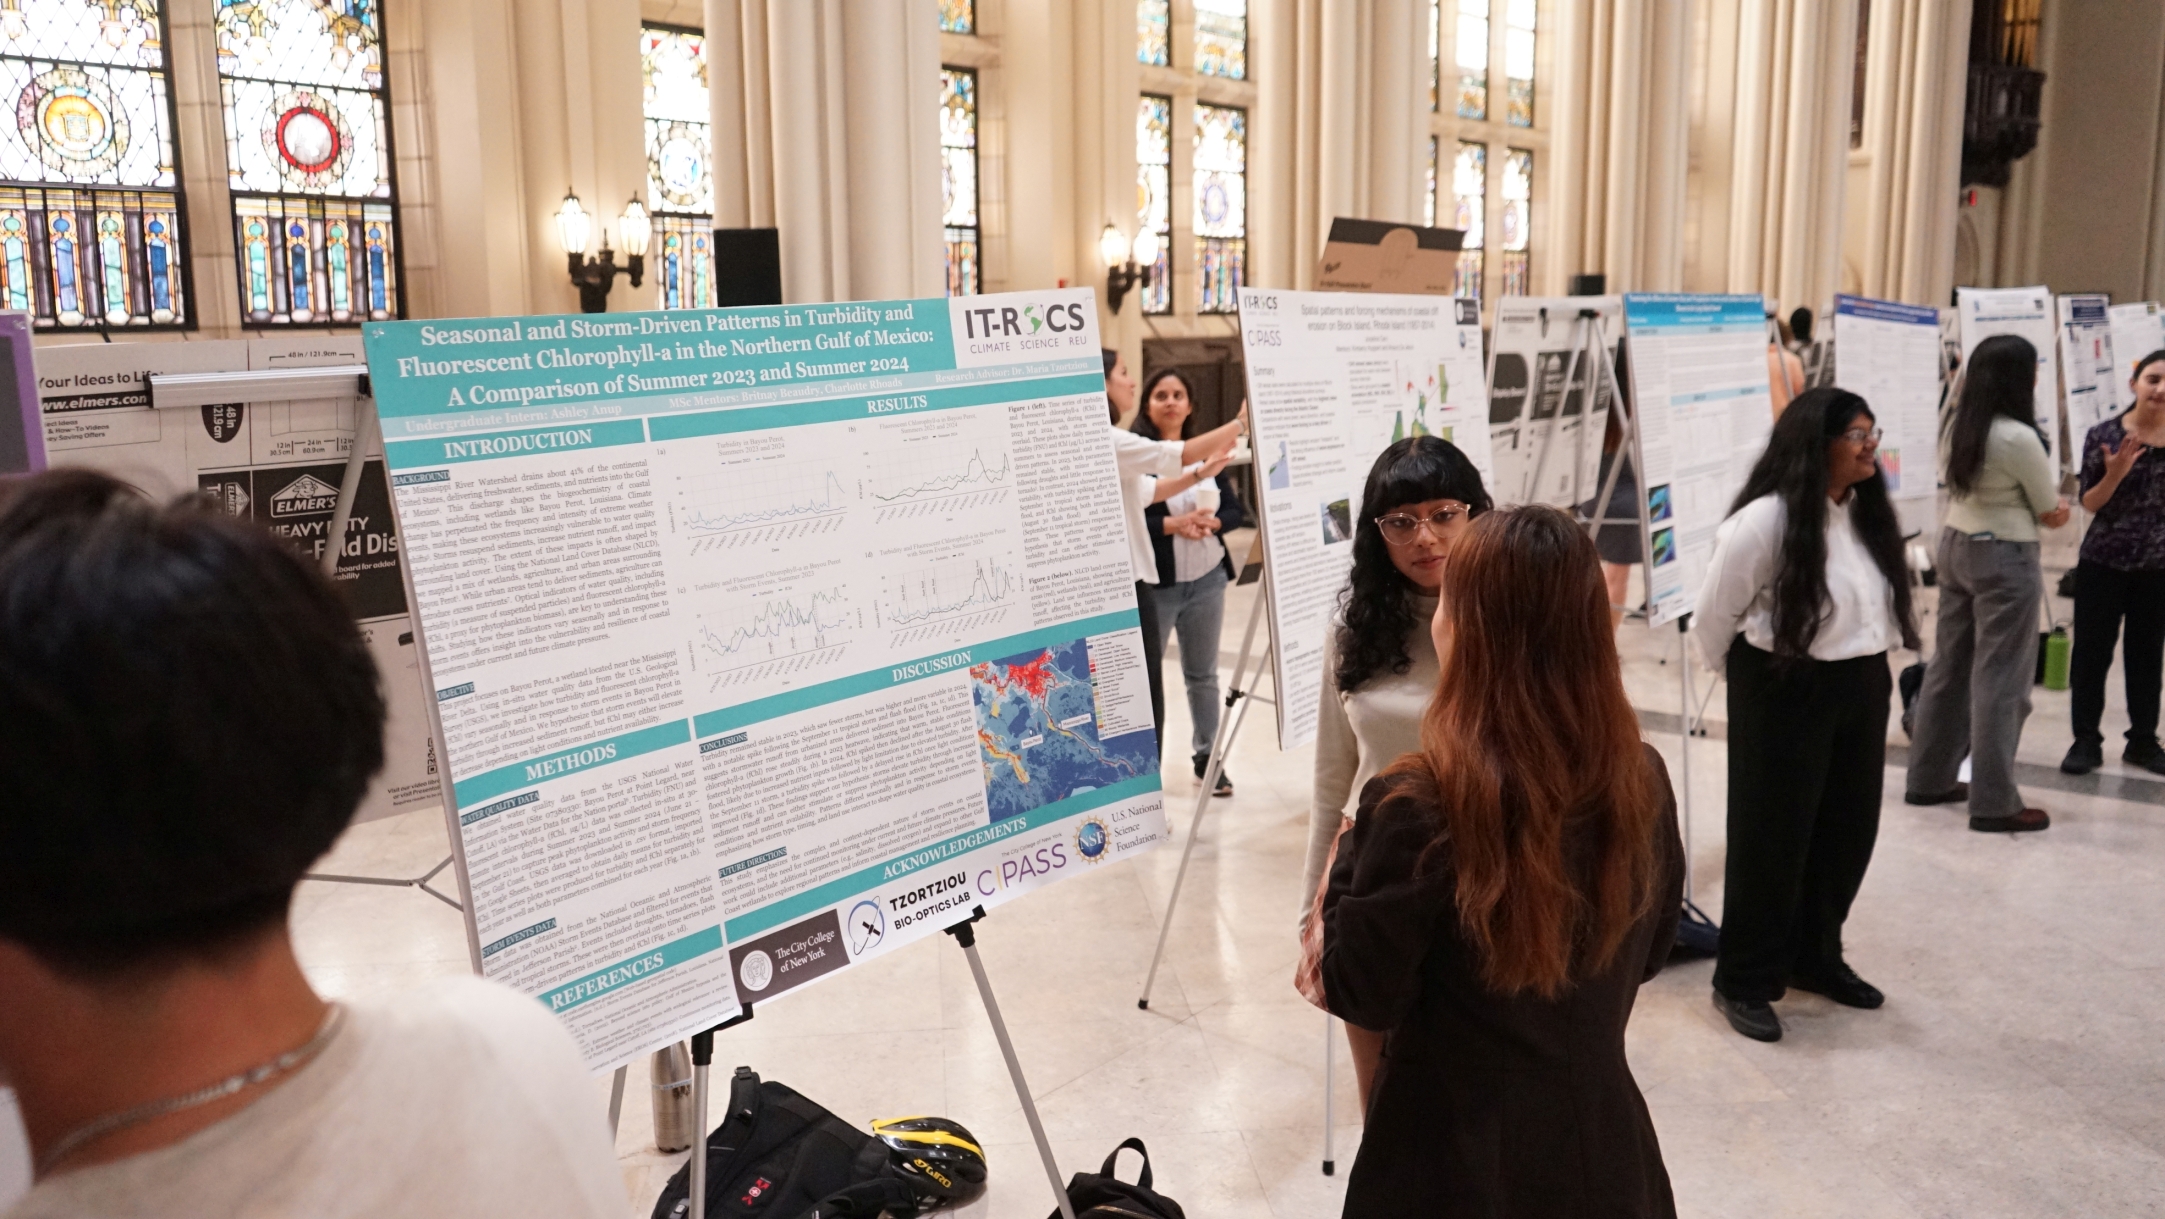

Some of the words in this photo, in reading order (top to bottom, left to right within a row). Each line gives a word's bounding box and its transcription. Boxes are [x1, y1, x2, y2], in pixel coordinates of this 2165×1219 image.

[421, 322, 522, 346] Seasonal
[527, 320, 566, 340] and
[571, 316, 702, 338] Storm-Driven
[706, 314, 780, 332] Patterns
[784, 310, 802, 326] in
[805, 306, 881, 326] Turbidity
[885, 304, 914, 322] and
[310, 350, 337, 358] 121.9cm
[397, 353, 532, 378] Fluorescent
[536, 343, 672, 369] Chlorophyll-a
[676, 342, 694, 360] in
[698, 340, 728, 358] the
[730, 336, 812, 356] Northern
[816, 332, 851, 350] Gulf
[854, 330, 870, 348] of
[874, 328, 934, 346] Mexico:
[970, 342, 1010, 354] CLIMATE
[1020, 338, 1060, 350] SCIENCE
[1069, 336, 1087, 346] REU
[75, 373, 114, 387] Ideas
[117, 373, 130, 384] to
[447, 388, 466, 406] A
[470, 378, 600, 405] Comparison
[604, 374, 624, 394] of
[628, 373, 708, 392] Summer
[713, 370, 756, 386] 2023
[760, 362, 792, 380] and
[796, 360, 866, 378] Summer
[870, 357, 909, 372] 2024
[935, 371, 974, 383] Research
[976, 366, 1010, 379] Advisor:
[1012, 366, 1024, 376] Dr.
[1026, 364, 1048, 374] Maria
[1050, 361, 1088, 372] Tzortziou
[669, 398, 692, 408] MSc
[694, 394, 739, 407] Mentors:
[742, 390, 778, 403] Britnay
[780, 386, 824, 399] Beaudry,
[824, 380, 868, 394] Charlotte
[870, 378, 902, 389] Rhoads
[867, 395, 928, 414] RESULTS
[405, 414, 503, 432] Undergraduate
[505, 412, 548, 424] Intern:
[551, 406, 589, 420] Ashley
[592, 404, 622, 416] Anup
[59, 433, 83, 441] Saving
[214, 426, 222, 438] cm
[444, 429, 592, 458] INTRODUCTION
[394, 472, 450, 486] BACKGROUND
[456, 481, 474, 490] River
[479, 474, 517, 486] Watershed
[522, 472, 543, 482] drains
[548, 468, 566, 478] about
[588, 465, 594, 474] of
[598, 464, 608, 472] the
[612, 459, 648, 470] continental
[276, 496, 336, 513] ELMER'S
[339, 564, 361, 574] board
[362, 562, 372, 570] for
[373, 560, 396, 570] added
[1029, 576, 1046, 584] Figure
[892, 651, 972, 683] DISCUSSION
[438, 683, 475, 700] OBJECTIVE
[700, 734, 748, 752] CONCLUSIONS
[524, 744, 618, 782] METHODS
[461, 810, 484, 826] WATER
[486, 799, 517, 817] QUALITY
[518, 792, 540, 805] DATA
[1111, 812, 1128, 823] U.S.
[1128, 800, 1162, 818] National
[1020, 842, 1036, 852] College
[1052, 832, 1062, 840] York
[1078, 832, 1104, 850] NSF
[1114, 822, 1140, 838] Science
[1116, 832, 1157, 852] Foundation
[882, 816, 1027, 880] ACKNOWLEDGEMENTS
[718, 862, 747, 878] FUTURE
[747, 848, 787, 868] DIRECTIONS
[720, 876, 733, 887] This
[736, 871, 752, 884] study
[756, 858, 788, 874] emphasizes
[791, 852, 800, 861] the
[804, 844, 826, 860] complex
[890, 871, 966, 912] TZORTZIOU
[894, 899, 952, 931] BIO-OPTICS
[952, 892, 970, 907] LAB
[482, 940, 505, 958] STORM
[505, 928, 534, 947] EVENTS
[535, 919, 557, 933] DATA
[776, 948, 790, 960] The
[790, 941, 808, 956] City
[808, 930, 835, 947] College
[780, 962, 790, 974] of
[790, 956, 808, 970] New
[808, 947, 826, 963] York
[550, 952, 664, 1011] REFERENCES
